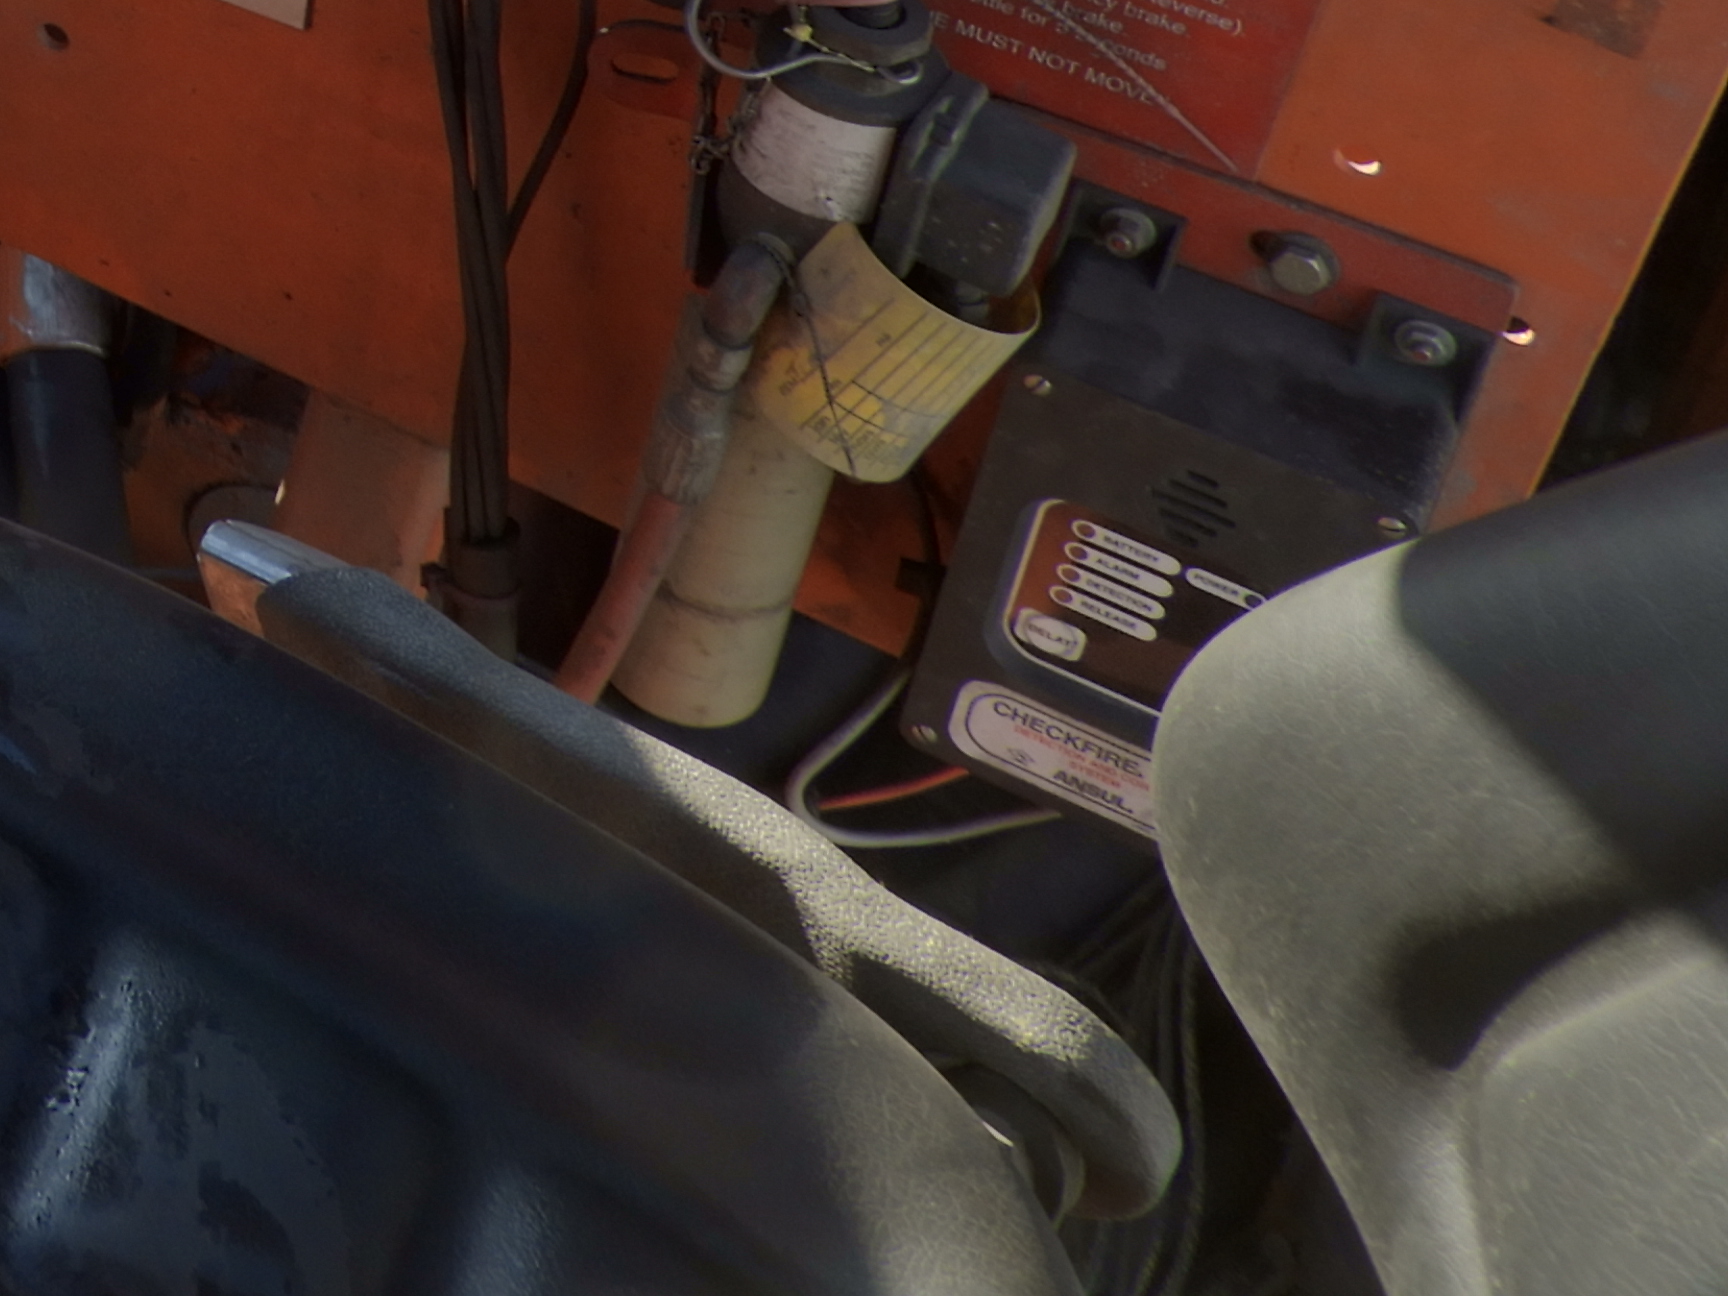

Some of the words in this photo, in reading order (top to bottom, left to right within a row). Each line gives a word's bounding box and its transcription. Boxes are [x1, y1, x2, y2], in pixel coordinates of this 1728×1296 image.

[1103, 535, 1160, 563] BATTERY
[1096, 558, 1141, 581] ALARM
[1085, 577, 1153, 612] DETECTION
[1080, 600, 1136, 630] RELEASE
